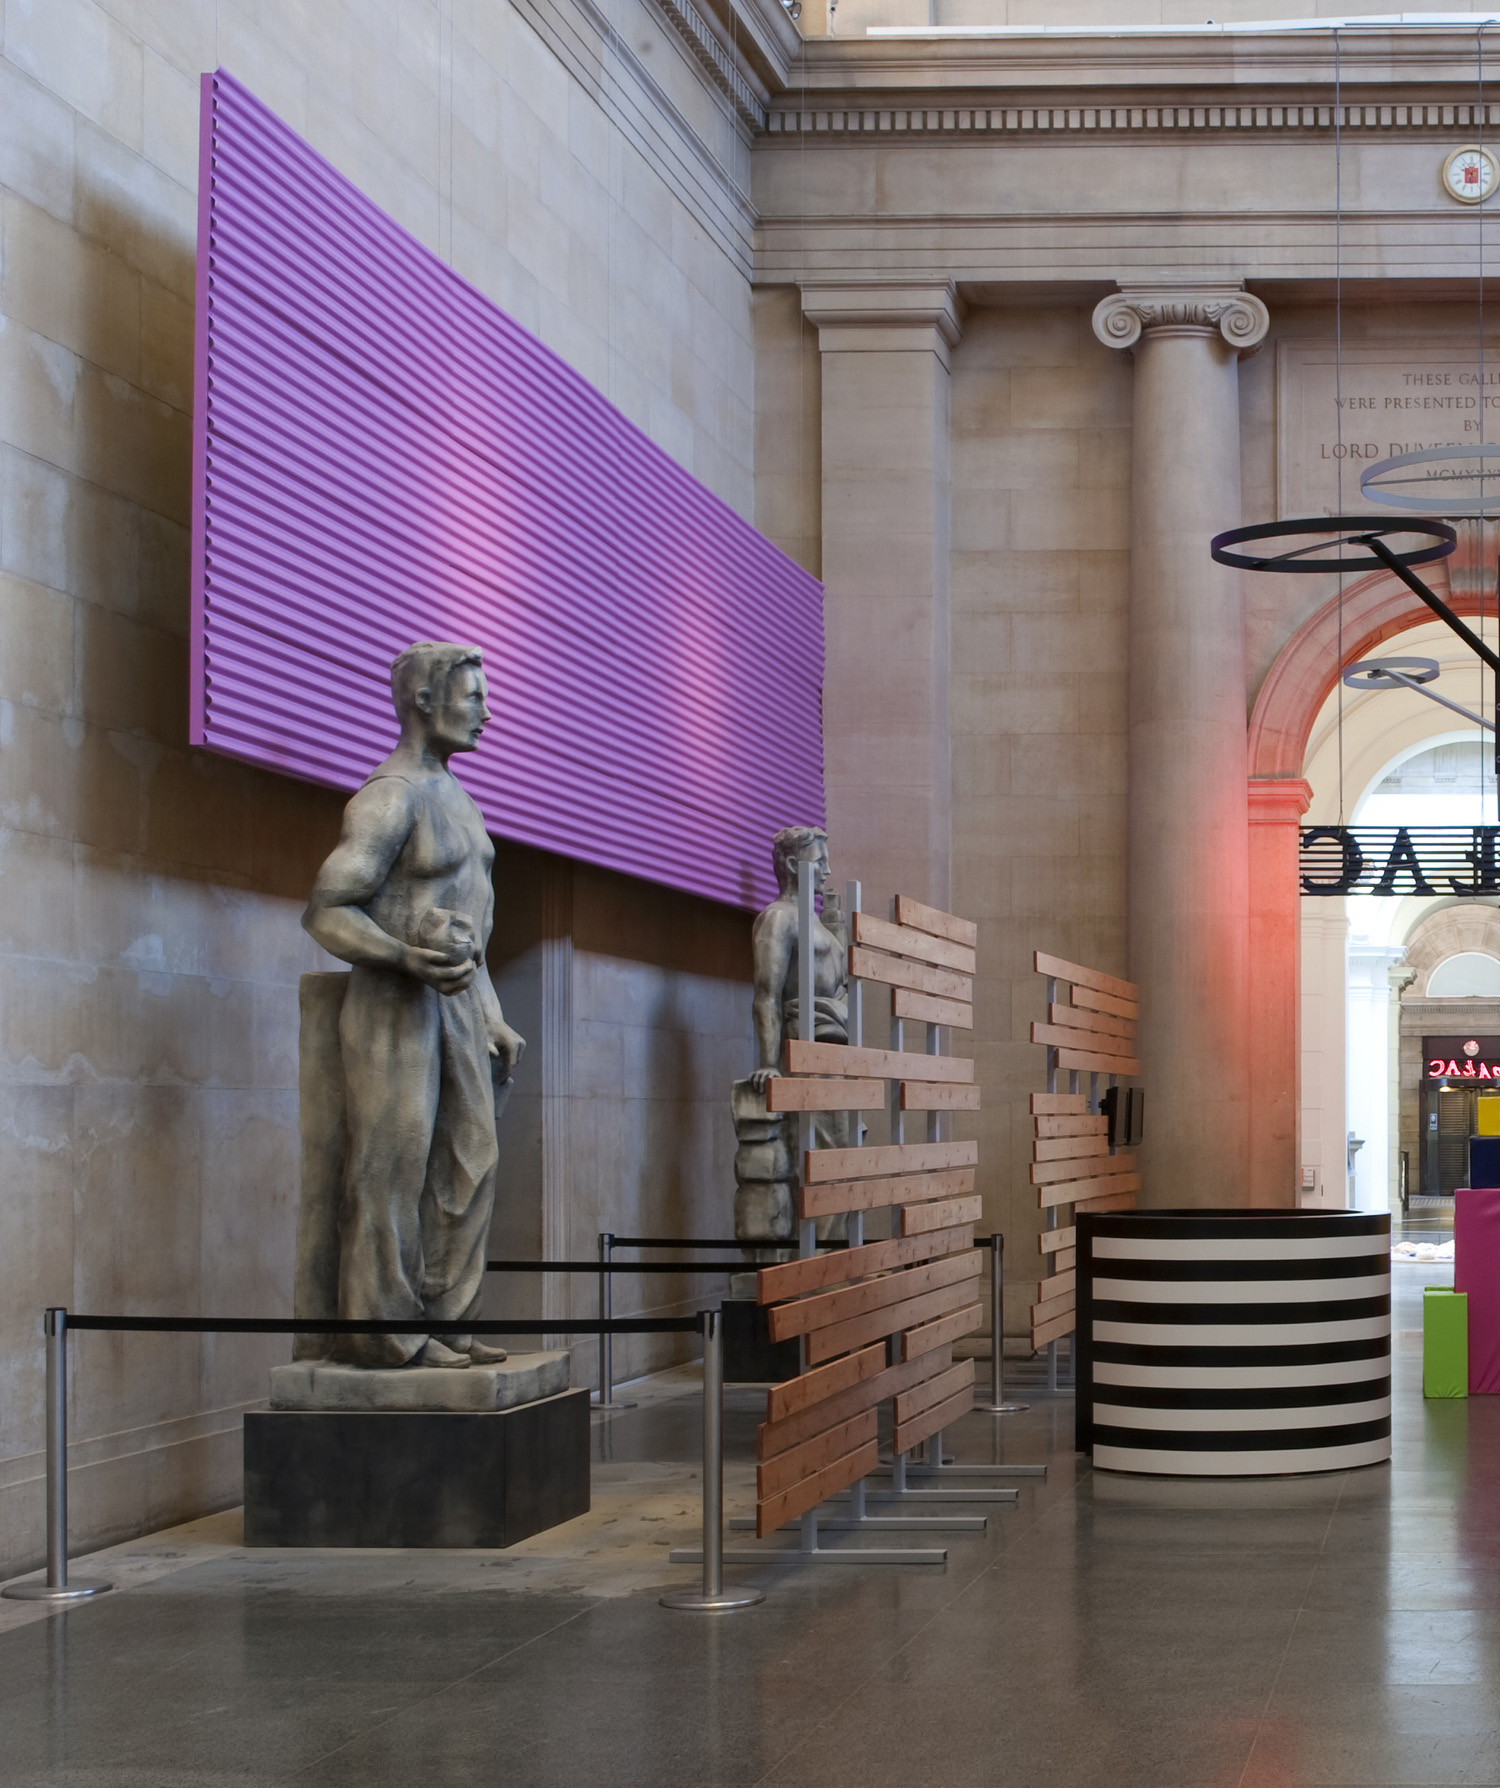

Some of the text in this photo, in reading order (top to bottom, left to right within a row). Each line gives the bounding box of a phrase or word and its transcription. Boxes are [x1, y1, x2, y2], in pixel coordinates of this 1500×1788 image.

[1402, 373, 1452, 386] THESE
[1334, 397, 1377, 410] WERE
[1384, 396, 1477, 410] PRESENTED
[1464, 419, 1481, 432] BY
[1321, 443, 1379, 459] LORD
